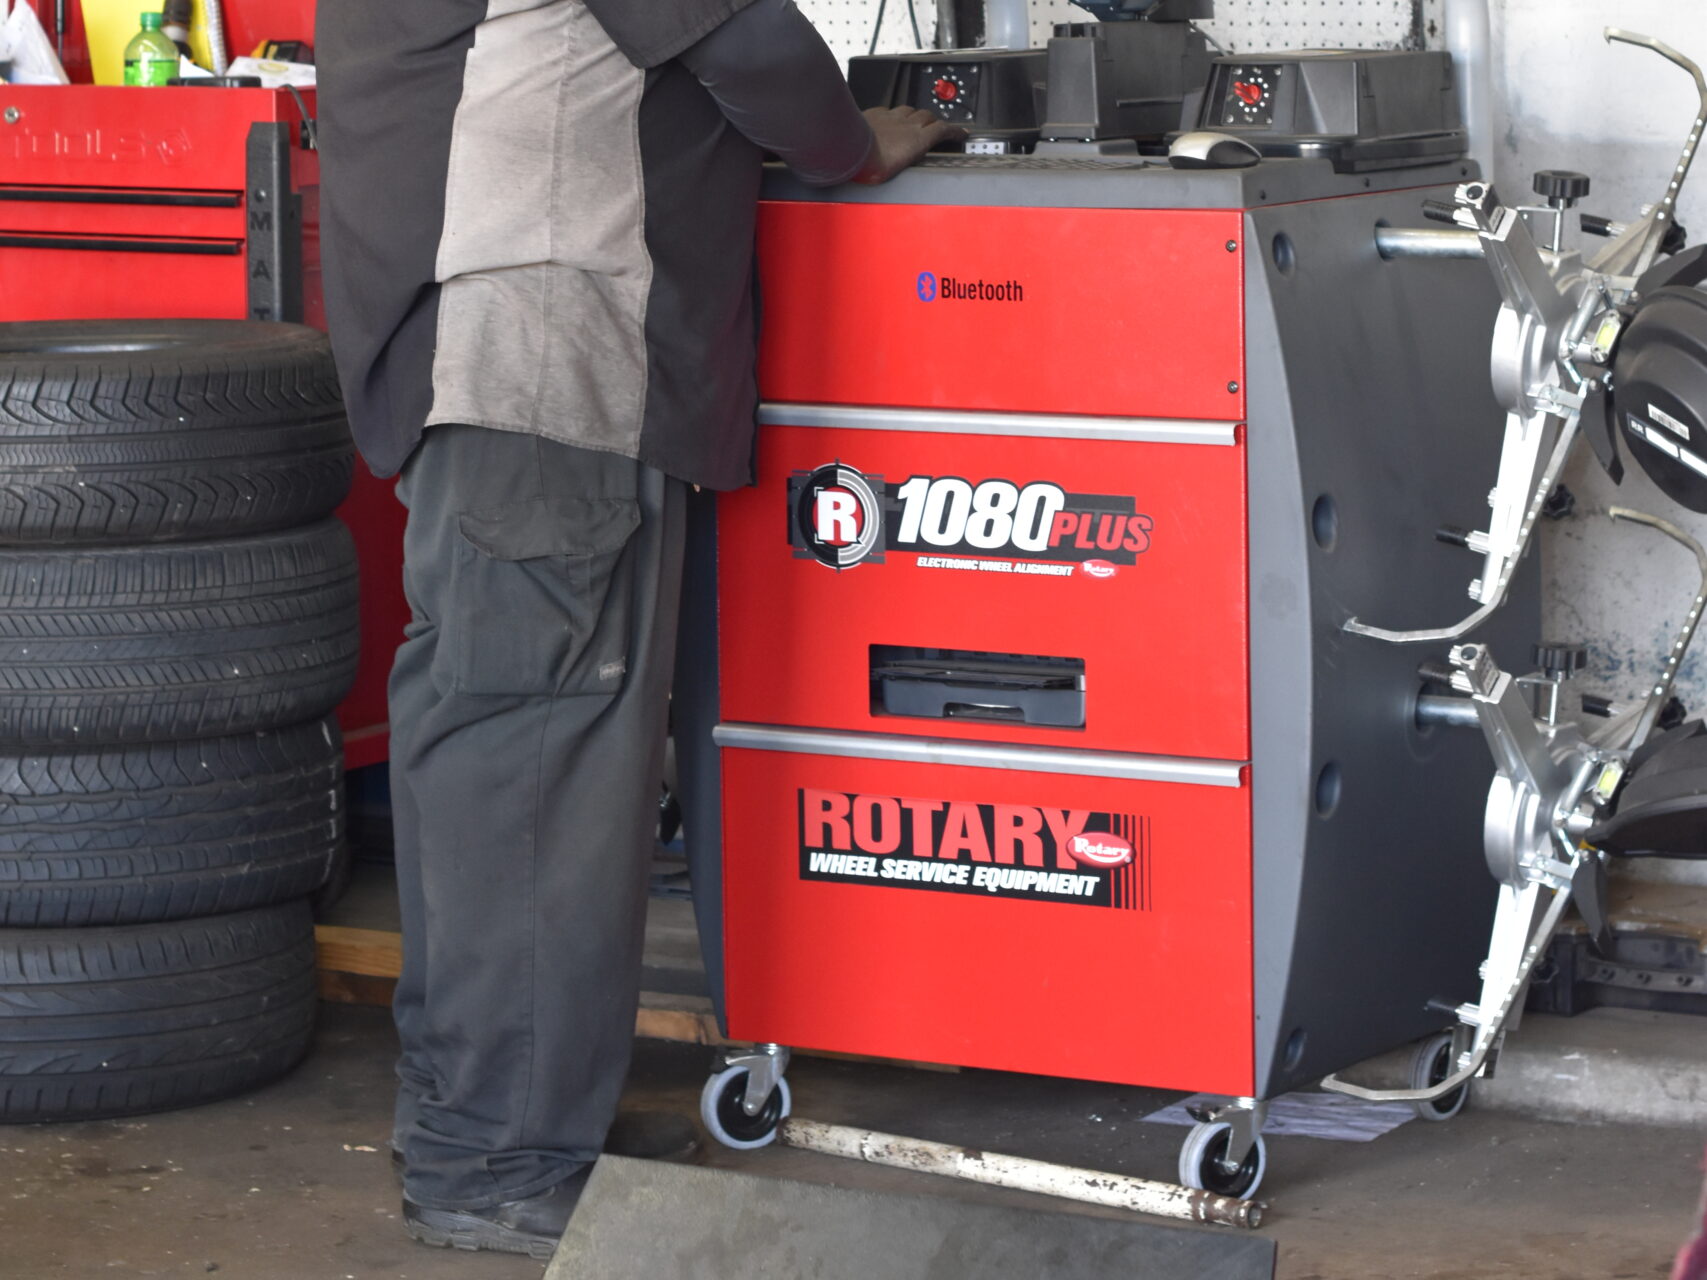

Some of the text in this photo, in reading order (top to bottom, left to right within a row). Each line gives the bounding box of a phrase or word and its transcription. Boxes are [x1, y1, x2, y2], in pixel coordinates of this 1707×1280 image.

[940, 277, 1024, 301] Bluetooth
[816, 490, 864, 546] R
[896, 477, 1154, 553] 1080 PLUS
[916, 556, 1076, 577] ELECTRONIC WHEEL ALIGNMENT
[803, 788, 1092, 871] ROTARY
[1073, 836, 1131, 862] Rotary
[809, 852, 1101, 897] WHEEL SERVICE EQUIPMENT
